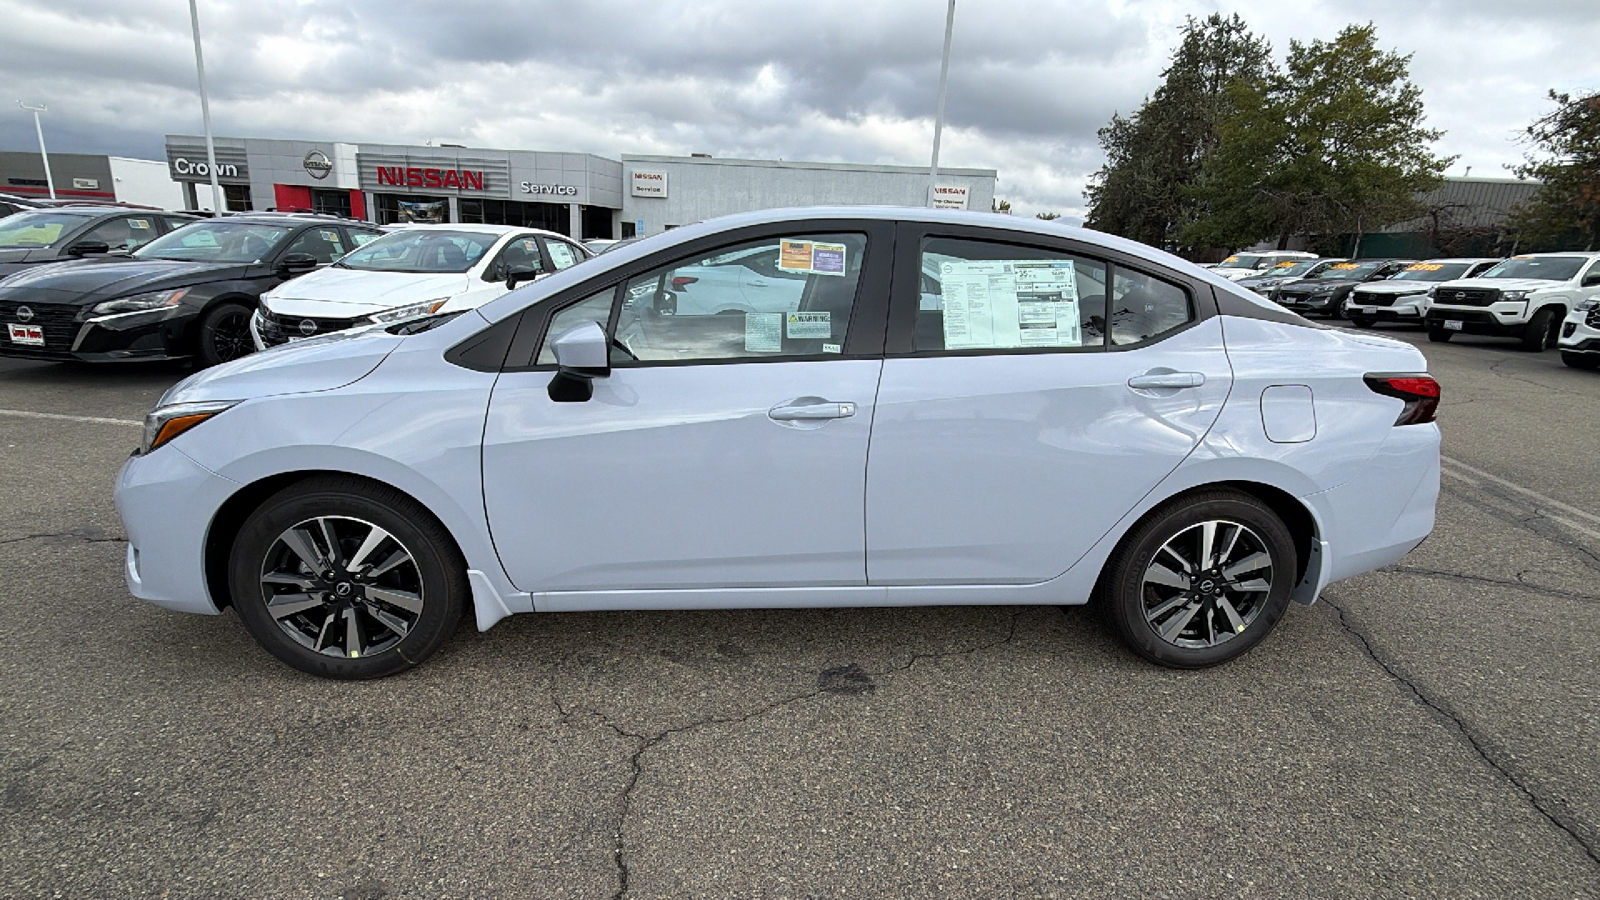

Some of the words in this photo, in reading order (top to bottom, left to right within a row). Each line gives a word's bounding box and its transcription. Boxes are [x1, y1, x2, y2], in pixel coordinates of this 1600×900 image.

[174, 157, 238, 177] Crown
[376, 166, 484, 190] NISSAN
[520, 181, 577, 195] Service
